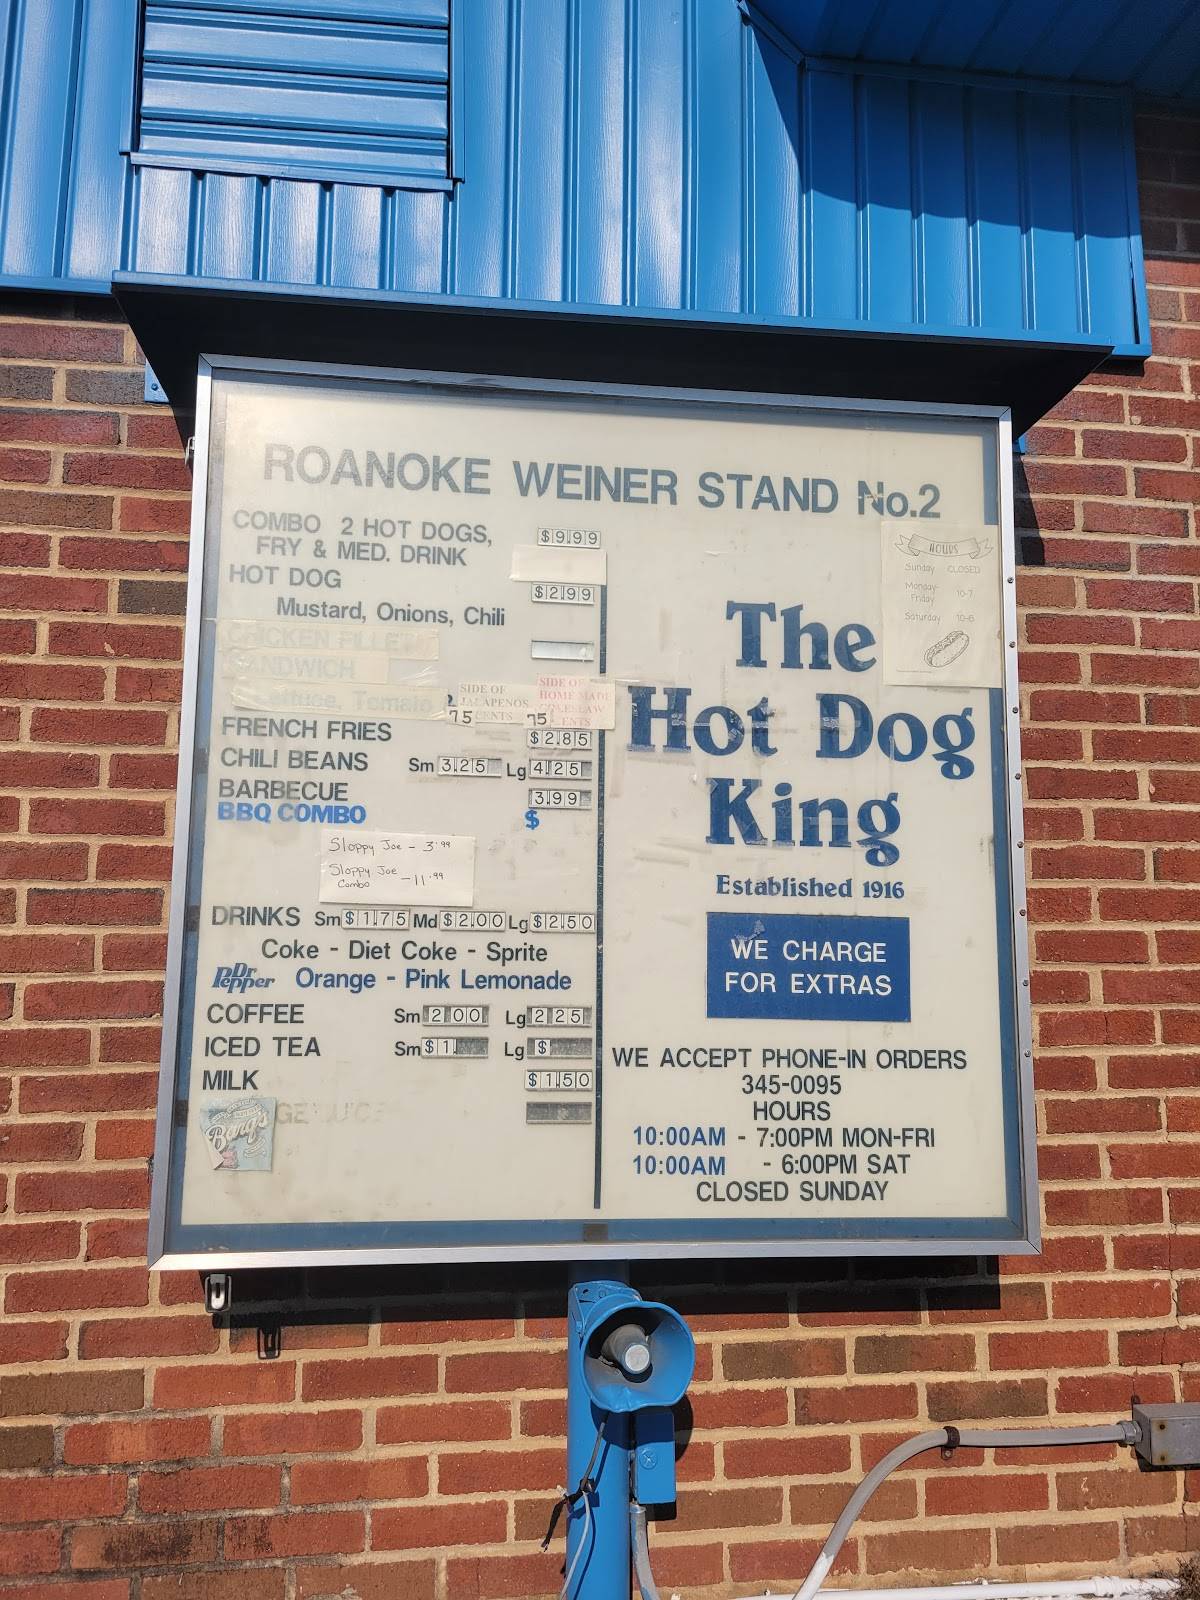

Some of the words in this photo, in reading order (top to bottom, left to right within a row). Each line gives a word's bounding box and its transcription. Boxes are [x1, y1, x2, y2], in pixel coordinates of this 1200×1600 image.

[263, 442, 491, 495] ROANOKE
[513, 460, 678, 506] WEINER
[699, 472, 838, 514] STAND
[858, 480, 941, 519] No.2
[233, 510, 321, 534] COMBO
[341, 517, 353, 535] 2
[363, 518, 411, 539] HOT
[421, 521, 493, 547] DOGS,
[541, 529, 597, 545] $9.99
[256, 537, 302, 556] FRY
[313, 541, 327, 558] &
[338, 543, 391, 562] MED.
[400, 545, 467, 566] DRINK
[929, 543, 960, 555] HOURS
[229, 564, 279, 585] HOT
[289, 567, 342, 589] DOG
[905, 563, 936, 576] Sunday
[946, 565, 981, 575] CLOSED
[535, 585, 591, 601] $2.99
[911, 594, 935, 607] Friday
[277, 597, 367, 622] Mustard,
[377, 602, 454, 627] Onions,
[464, 605, 505, 626] Chili
[905, 612, 941, 625] Saturday
[725, 601, 877, 673] The
[460, 684, 488, 693] SIDE
[538, 677, 565, 686] SIDE
[539, 690, 573, 700] HOME
[475, 711, 513, 721] CENTS
[221, 716, 322, 740] FRENCH
[326, 720, 392, 741] FRIES
[530, 731, 588, 747] $2.85
[627, 686, 778, 757] Hot
[815, 693, 976, 781] Dog
[220, 747, 278, 769] CHILI
[288, 750, 369, 772] BEANS
[408, 757, 434, 772] Sm
[441, 758, 486, 773] 3.25
[506, 763, 527, 780] Lg
[533, 761, 579, 776] 4.25
[218, 778, 349, 801] BARBECUE
[534, 791, 578, 805] 3.99
[217, 802, 272, 823] BBQ
[277, 803, 367, 825] COMBO
[524, 809, 540, 830] $
[705, 777, 901, 867] King
[329, 837, 375, 856] Sloppy
[381, 839, 402, 850] Joe
[329, 863, 370, 877] Sloppy
[377, 865, 398, 875] Joe
[337, 879, 370, 889] Combo
[715, 874, 853, 899] Established
[862, 880, 905, 899] 1916
[211, 906, 301, 926] DRINKS
[314, 911, 340, 926] Sm
[345, 911, 406, 926] $1.75
[413, 914, 438, 928] Md
[443, 913, 503, 928] $2.00
[509, 915, 528, 933] Lg
[533, 915, 592, 929] $2.50
[261, 938, 319, 959] Coke
[349, 940, 391, 960] Diet
[401, 940, 457, 961] Coke
[486, 942, 548, 965] Sprite
[731, 938, 769, 960] WE
[782, 940, 888, 963] CHARGE
[212, 966, 276, 994] Pepper
[232, 962, 258, 977] Dr
[295, 967, 376, 993] Orange
[406, 968, 450, 989] Pink
[461, 969, 572, 990] Lemonade
[725, 971, 777, 993] FOR
[790, 973, 893, 996] EXTRAS
[206, 1003, 305, 1024] COFFEE
[394, 1008, 420, 1023] Sm
[506, 1010, 526, 1028] Lg
[204, 1036, 260, 1058] ICED
[273, 1036, 321, 1057] TEA
[394, 1041, 421, 1057] Sm
[504, 1042, 525, 1060] Lg
[612, 1047, 649, 1068] WE
[660, 1047, 752, 1069] ACCEPT
[762, 1048, 866, 1069] PHONE-IN
[876, 1049, 967, 1070] ORDERS
[202, 1069, 259, 1091] MILK
[529, 1072, 590, 1087] $1.50
[741, 1074, 842, 1095] 345-0095
[753, 1101, 831, 1122] HOURS
[632, 1126, 726, 1147] 10:00AM
[756, 1127, 833, 1148] 7:00PM
[842, 1128, 935, 1148] MON-FRI
[632, 1155, 726, 1176] 10:00AM
[781, 1153, 858, 1174] 6:00PM
[867, 1154, 911, 1175] SAT
[696, 1181, 789, 1202] CLOSED
[799, 1180, 889, 1202] SUNDAY
